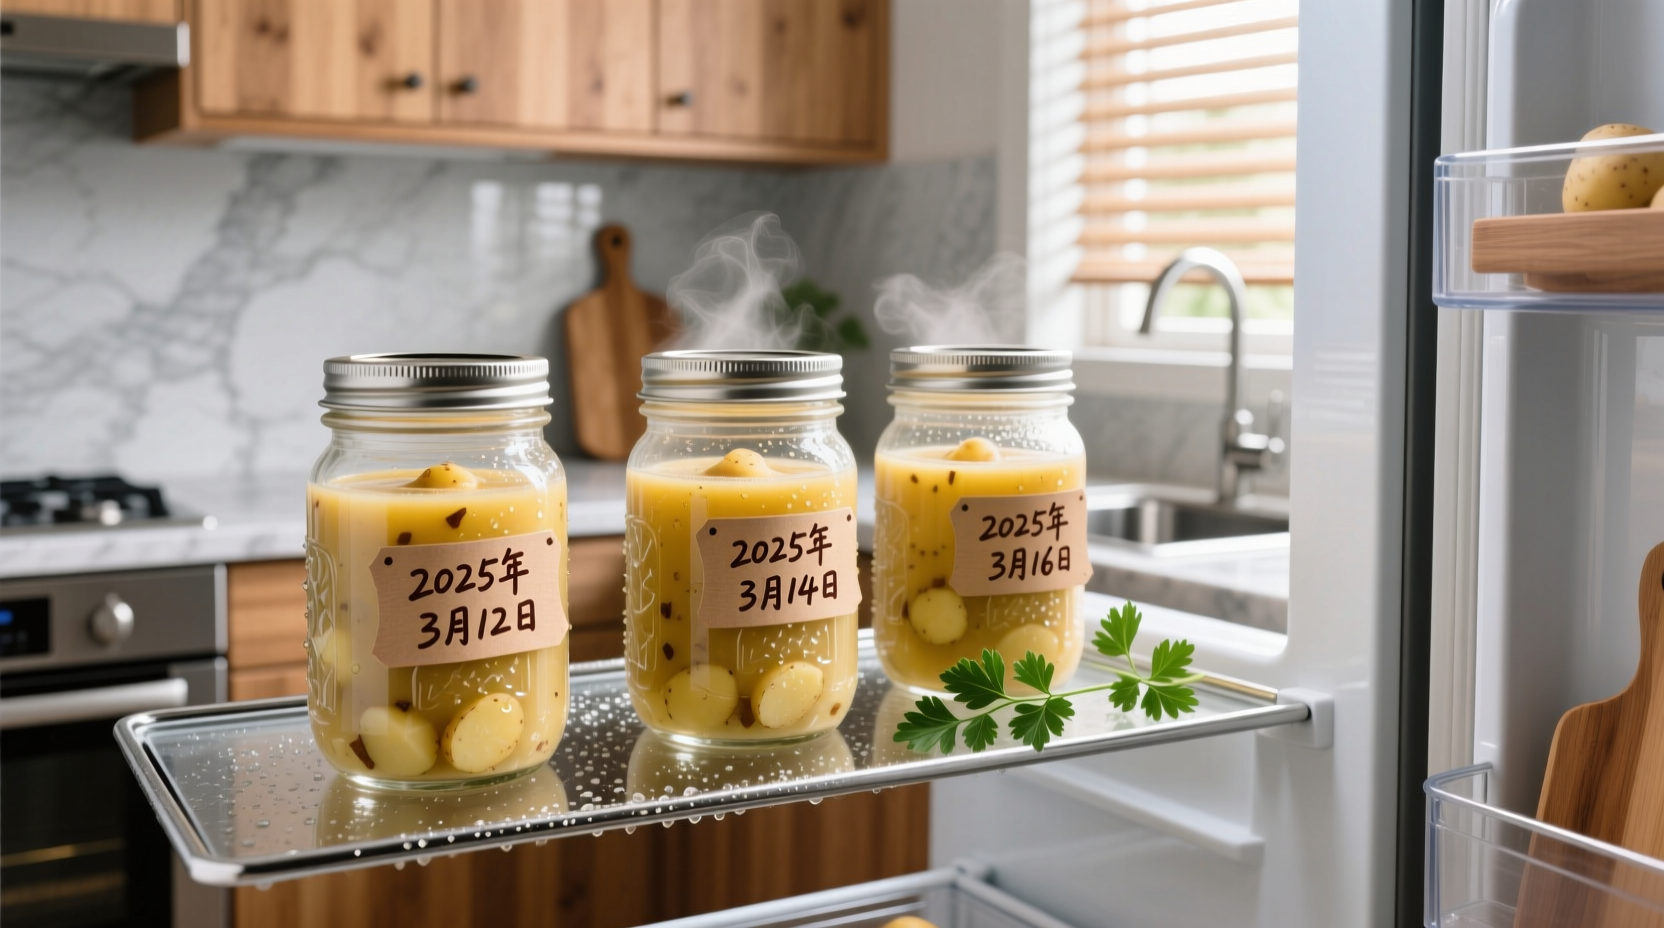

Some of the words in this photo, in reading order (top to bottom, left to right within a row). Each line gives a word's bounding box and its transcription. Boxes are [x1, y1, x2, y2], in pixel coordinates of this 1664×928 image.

[979, 502, 1068, 542] 2025年
[730, 523, 832, 568] 2025年
[988, 545, 1070, 581] 3月16日
[408, 547, 530, 602] 2025年
[738, 570, 837, 612] 3月14日
[417, 599, 536, 650] 3月12日
